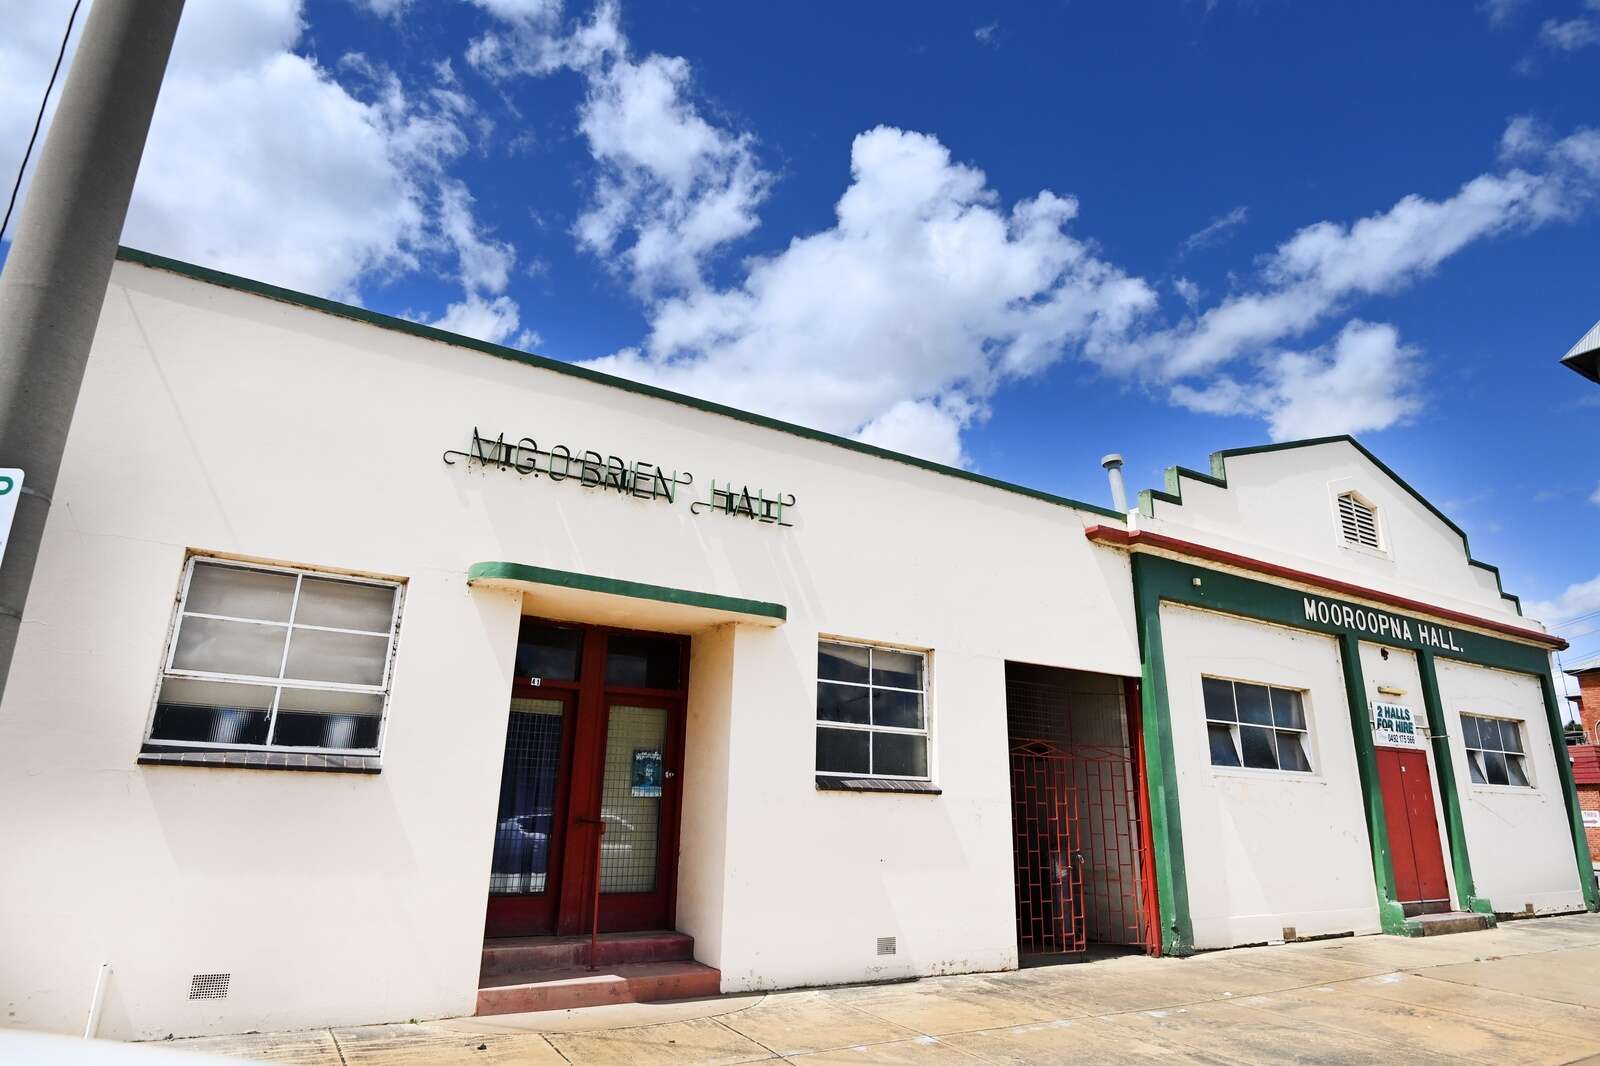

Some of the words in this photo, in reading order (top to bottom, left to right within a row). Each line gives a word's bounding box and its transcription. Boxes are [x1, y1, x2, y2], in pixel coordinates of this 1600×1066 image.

[548, 443, 677, 504] O'BRIEN
[708, 478, 794, 527] HALL
[1303, 597, 1413, 642] MOOROOPNA
[1376, 717, 1394, 732] FOR
[1395, 720, 1414, 734] HIRE
[1377, 705, 1383, 718] 2
[1384, 705, 1411, 721] HALLS
